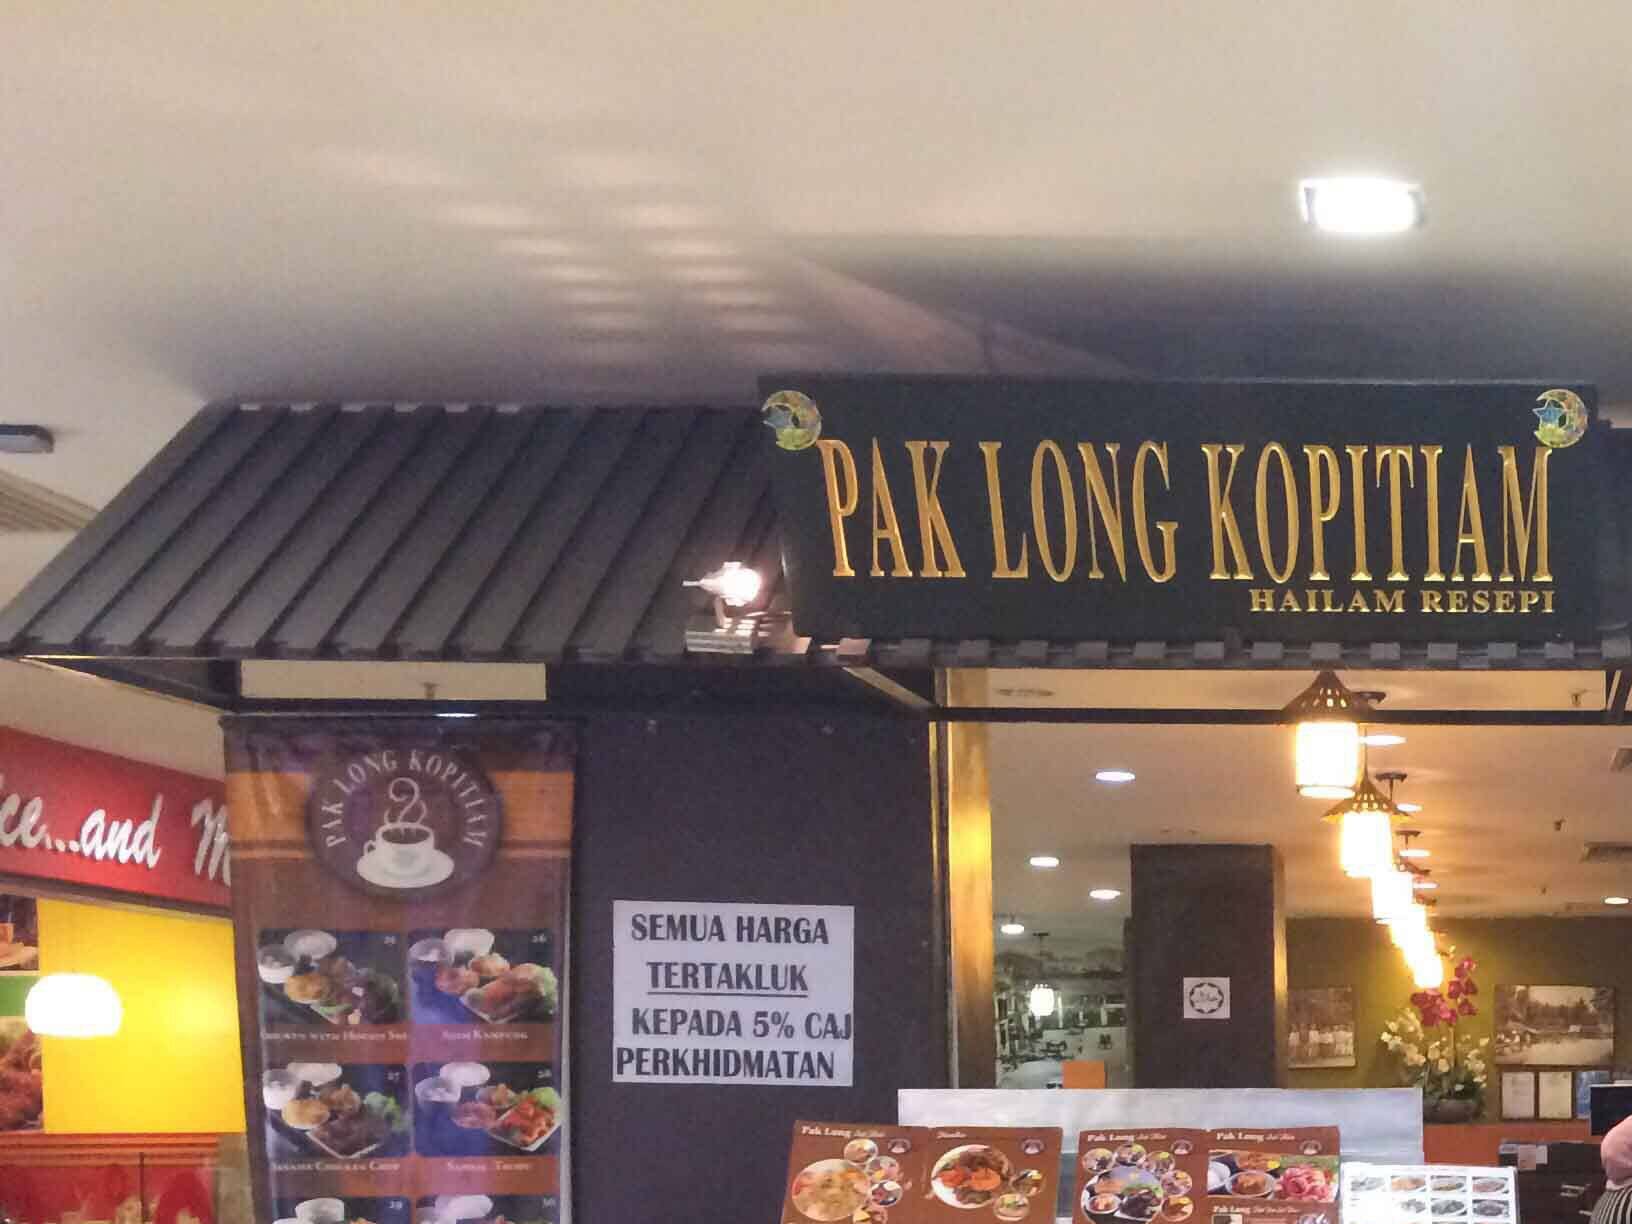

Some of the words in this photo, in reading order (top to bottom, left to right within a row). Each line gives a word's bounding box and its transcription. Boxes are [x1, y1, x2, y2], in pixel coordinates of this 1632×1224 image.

[816, 439, 966, 577] PAK
[978, 439, 1179, 583] LONG
[1202, 441, 1555, 585] KOPITIAM
[1249, 589, 1406, 614] HAILAM
[1421, 589, 1555, 614] RESEPI
[333, 750, 398, 795] LONG
[408, 749, 488, 848] KOPITIAM
[321, 798, 347, 848] PAK
[631, 914, 726, 943] SEMUA
[736, 916, 829, 945] HARGA
[646, 961, 809, 992] TERTAKLUK
[632, 1007, 742, 1038] KEPADA
[753, 1011, 795, 1039] 5%
[804, 1012, 852, 1040] CAJ
[616, 1047, 834, 1079] PERKHIDMATAN
